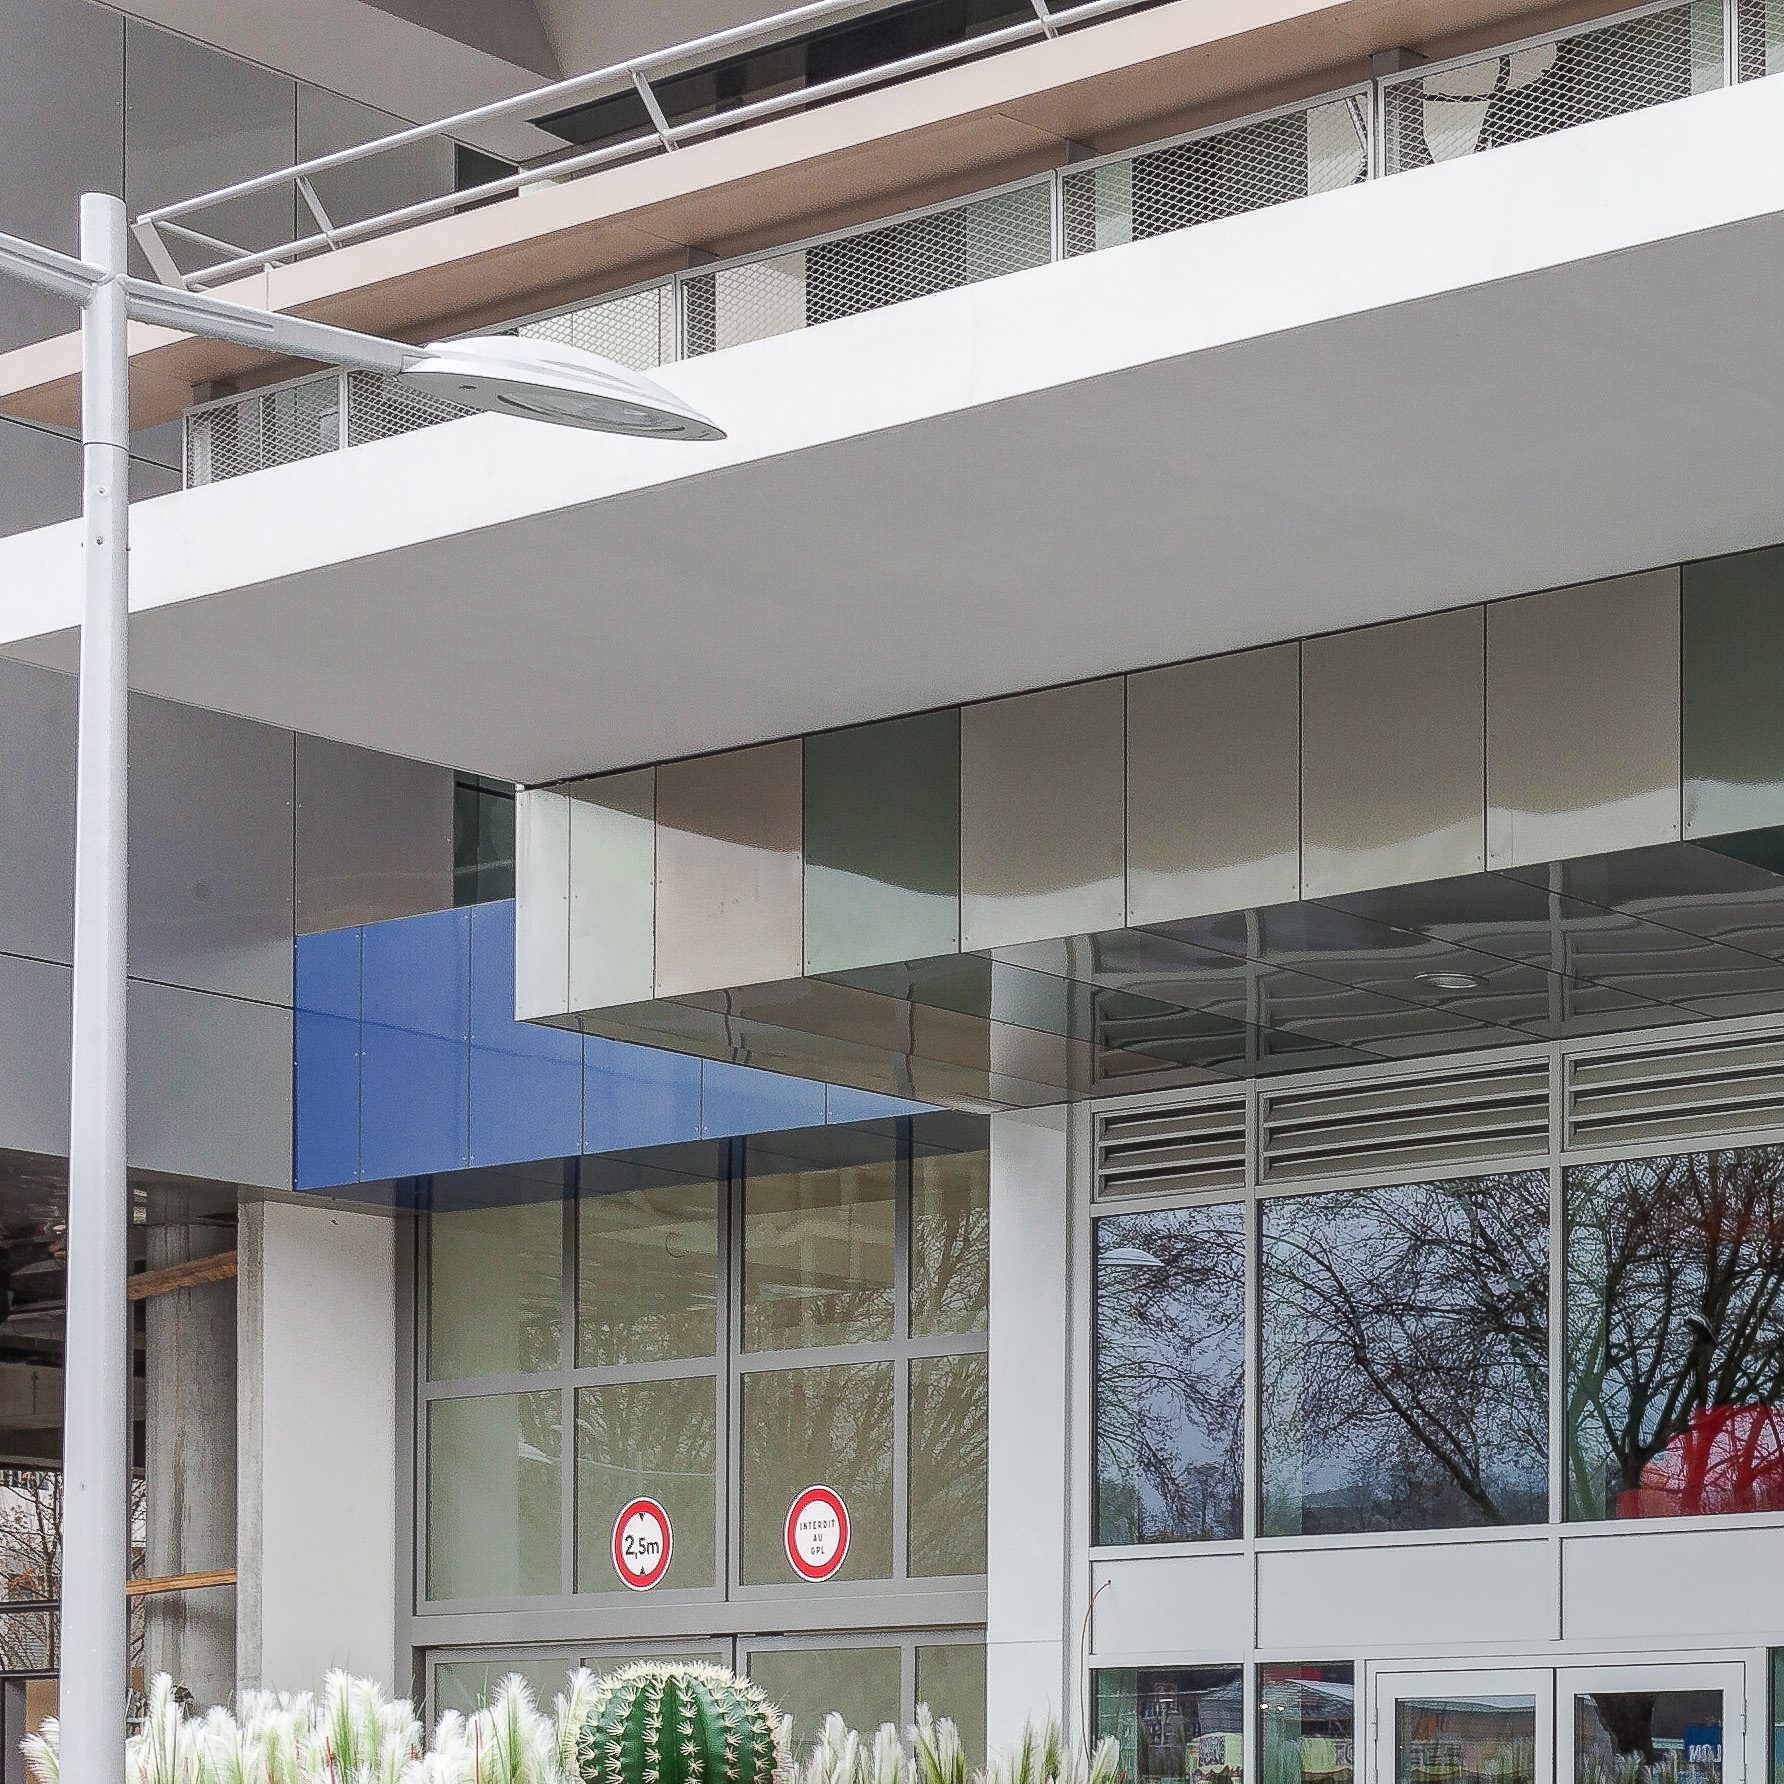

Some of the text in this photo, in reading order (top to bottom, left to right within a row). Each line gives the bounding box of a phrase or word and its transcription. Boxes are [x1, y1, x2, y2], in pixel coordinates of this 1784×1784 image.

[799, 1519, 836, 1531] INTERDIT
[812, 1533, 823, 1542] AU
[624, 1534, 660, 1559] 2,5m
[810, 1546, 825, 1555] GPL
